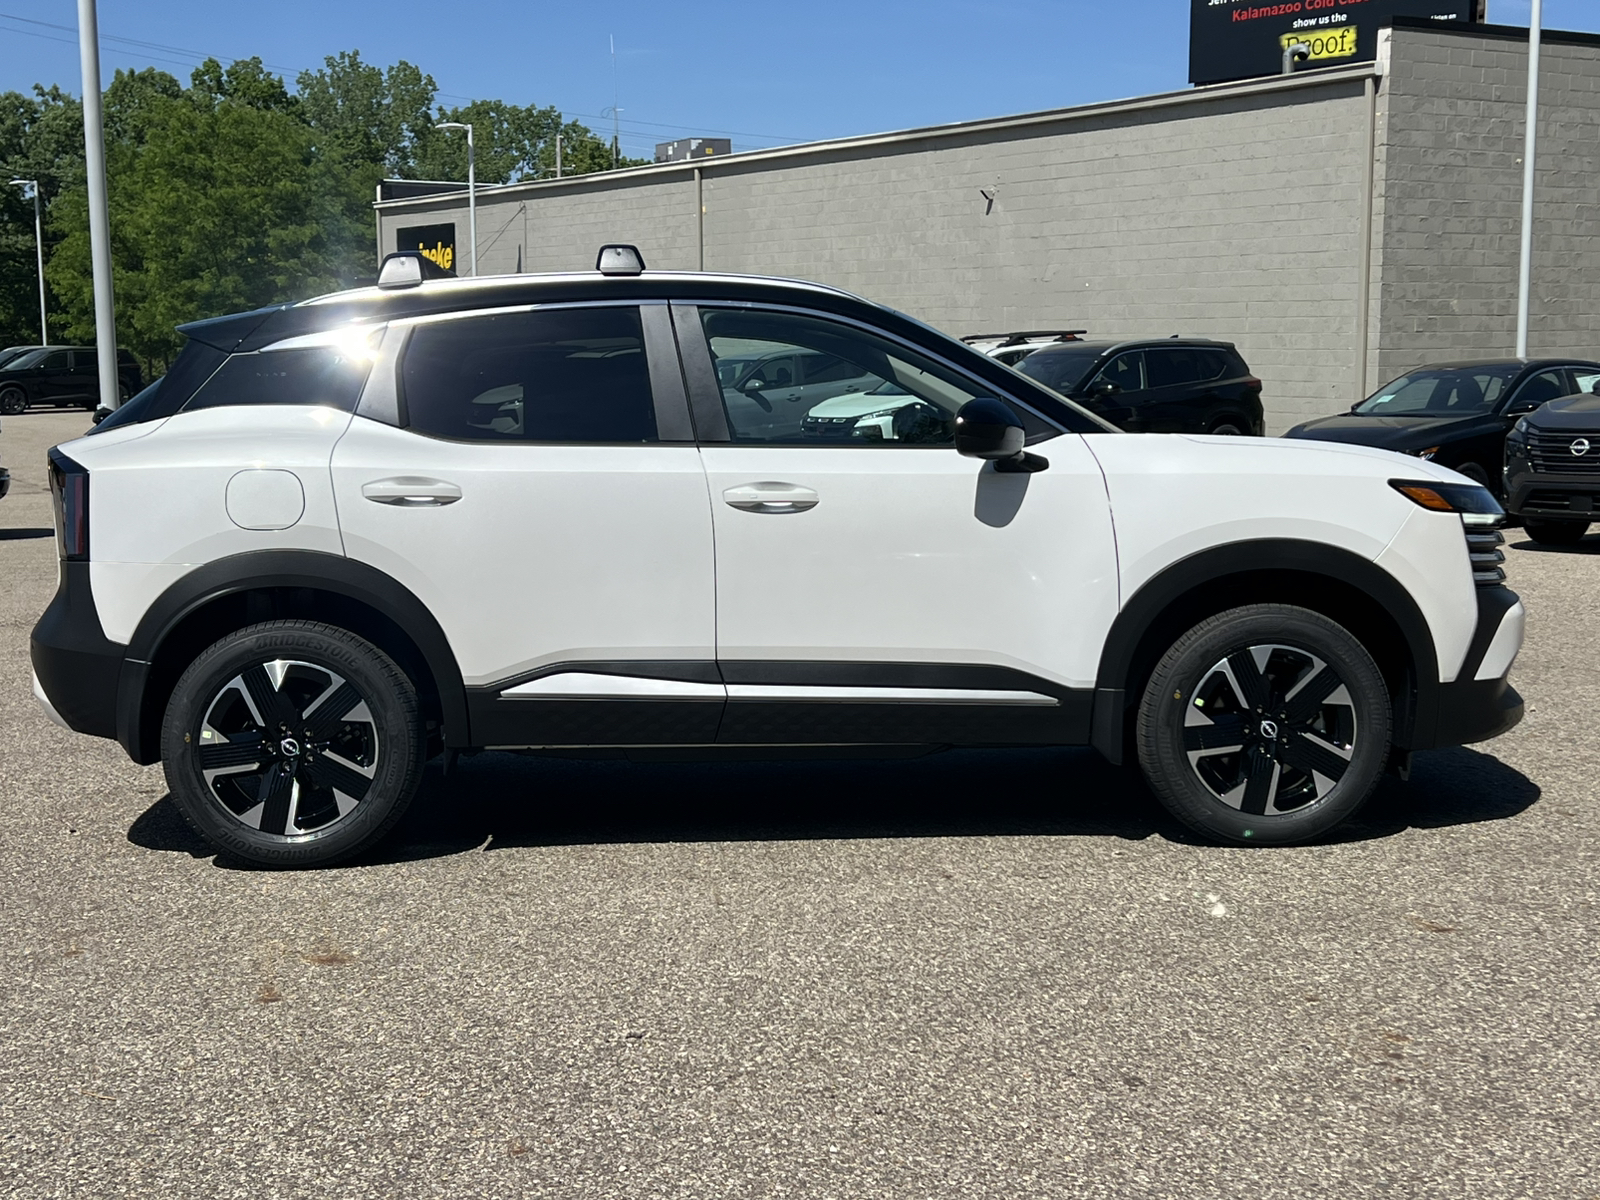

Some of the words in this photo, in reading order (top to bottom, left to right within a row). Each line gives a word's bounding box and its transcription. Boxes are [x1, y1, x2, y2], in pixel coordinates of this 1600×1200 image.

[1232, 2, 1301, 22] Kalamazoo
[1305, 0, 1335, 10] Cold
[1292, 18, 1317, 28] show
[1318, 16, 1330, 25] us
[1331, 13, 1347, 23] the
[256, 635, 358, 667] BRIDGESTONE
[216, 828, 320, 860] BRIDGESTONE
